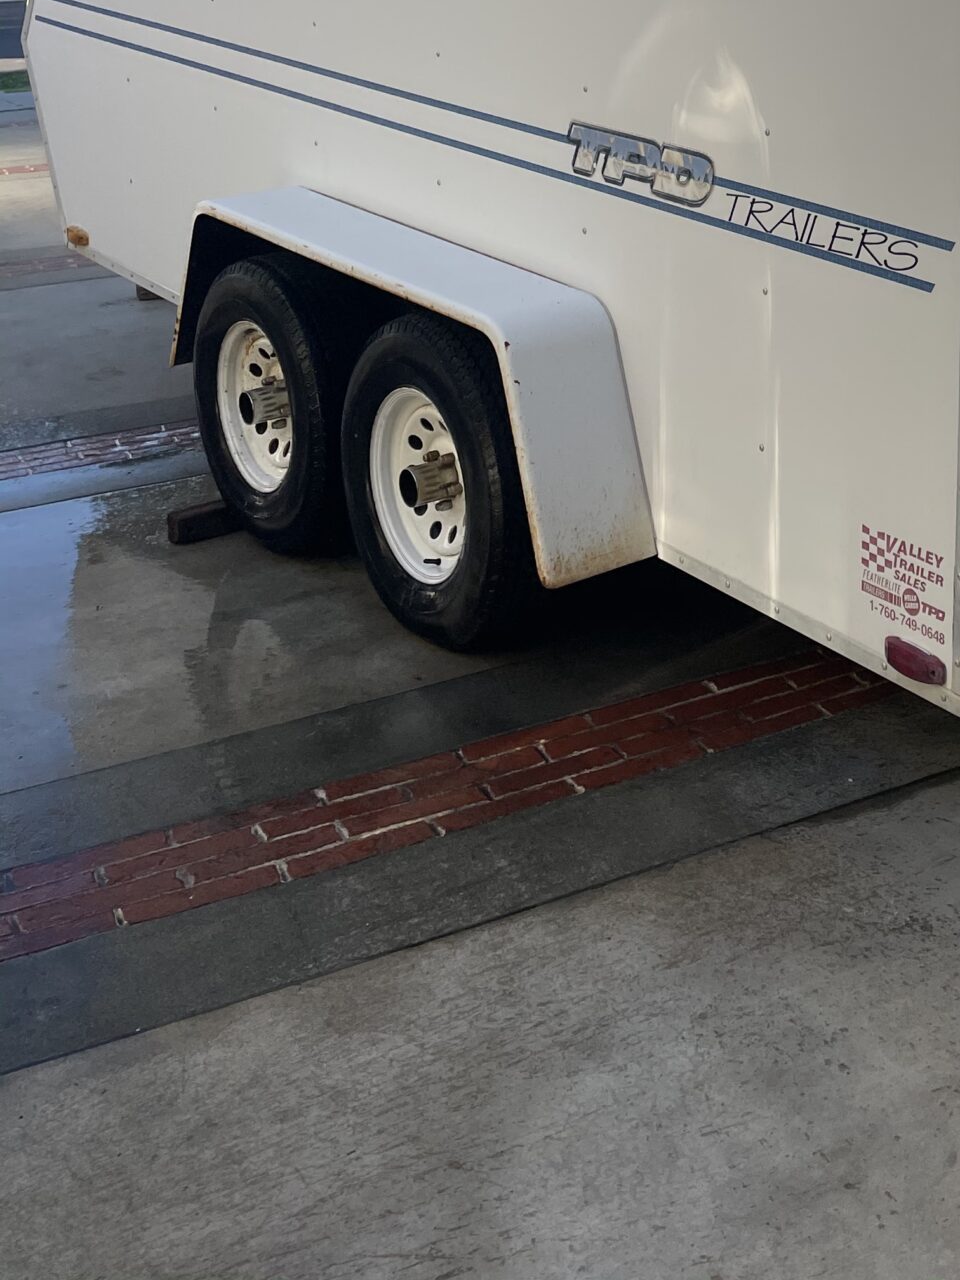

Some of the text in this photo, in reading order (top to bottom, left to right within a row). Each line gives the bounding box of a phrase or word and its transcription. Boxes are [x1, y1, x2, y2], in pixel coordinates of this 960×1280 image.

[726, 192, 919, 272] TRAILERS
[886, 534, 944, 568] VALLEY
[862, 568, 901, 595] FEATHERLITE
[892, 552, 944, 587] TRAILER
[893, 569, 927, 593] SALES
[869, 599, 945, 645] 1-760-749-0648
[921, 601, 946, 622] TPD
